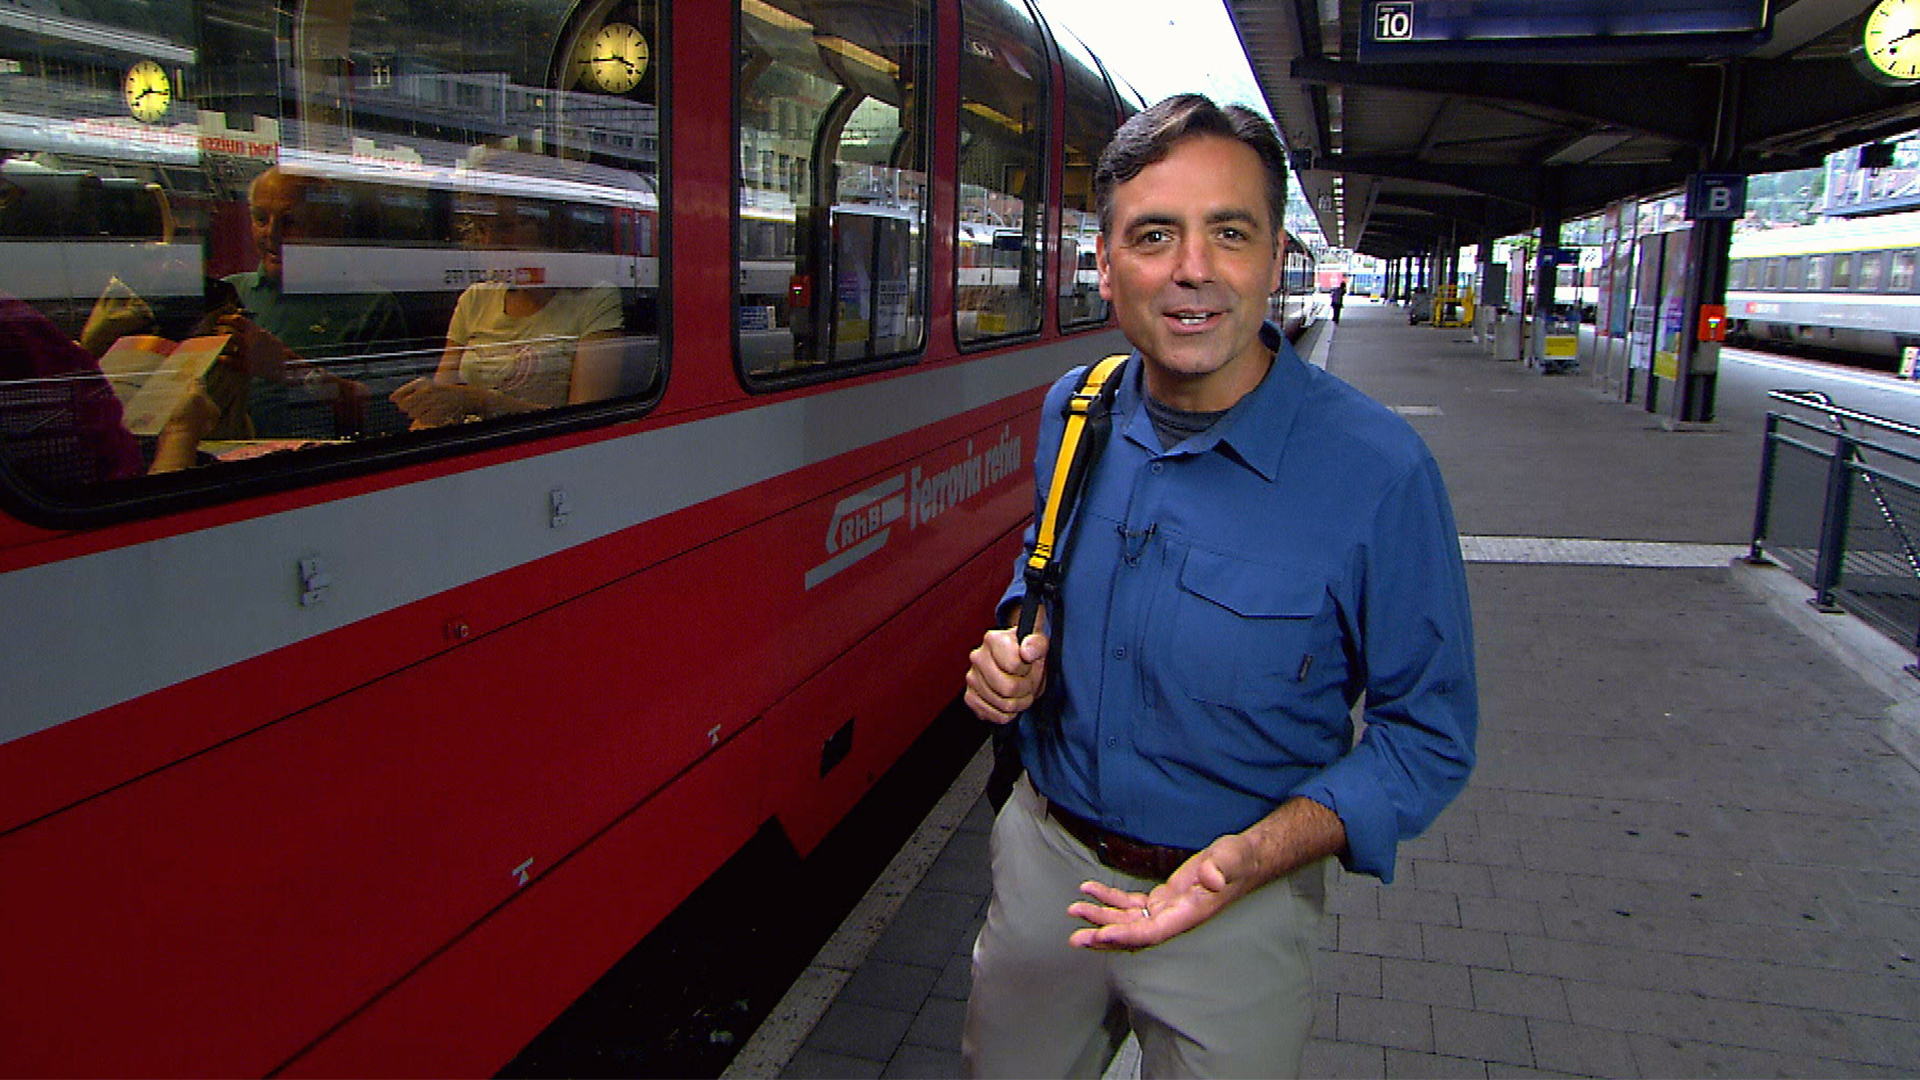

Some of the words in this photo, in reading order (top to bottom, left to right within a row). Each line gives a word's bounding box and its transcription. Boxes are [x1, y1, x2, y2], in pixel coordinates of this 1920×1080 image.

[1378, 13, 1409, 37] 10
[1709, 186, 1731, 211] B
[909, 439, 982, 531] Ferrovia
[841, 504, 883, 548] RhB
